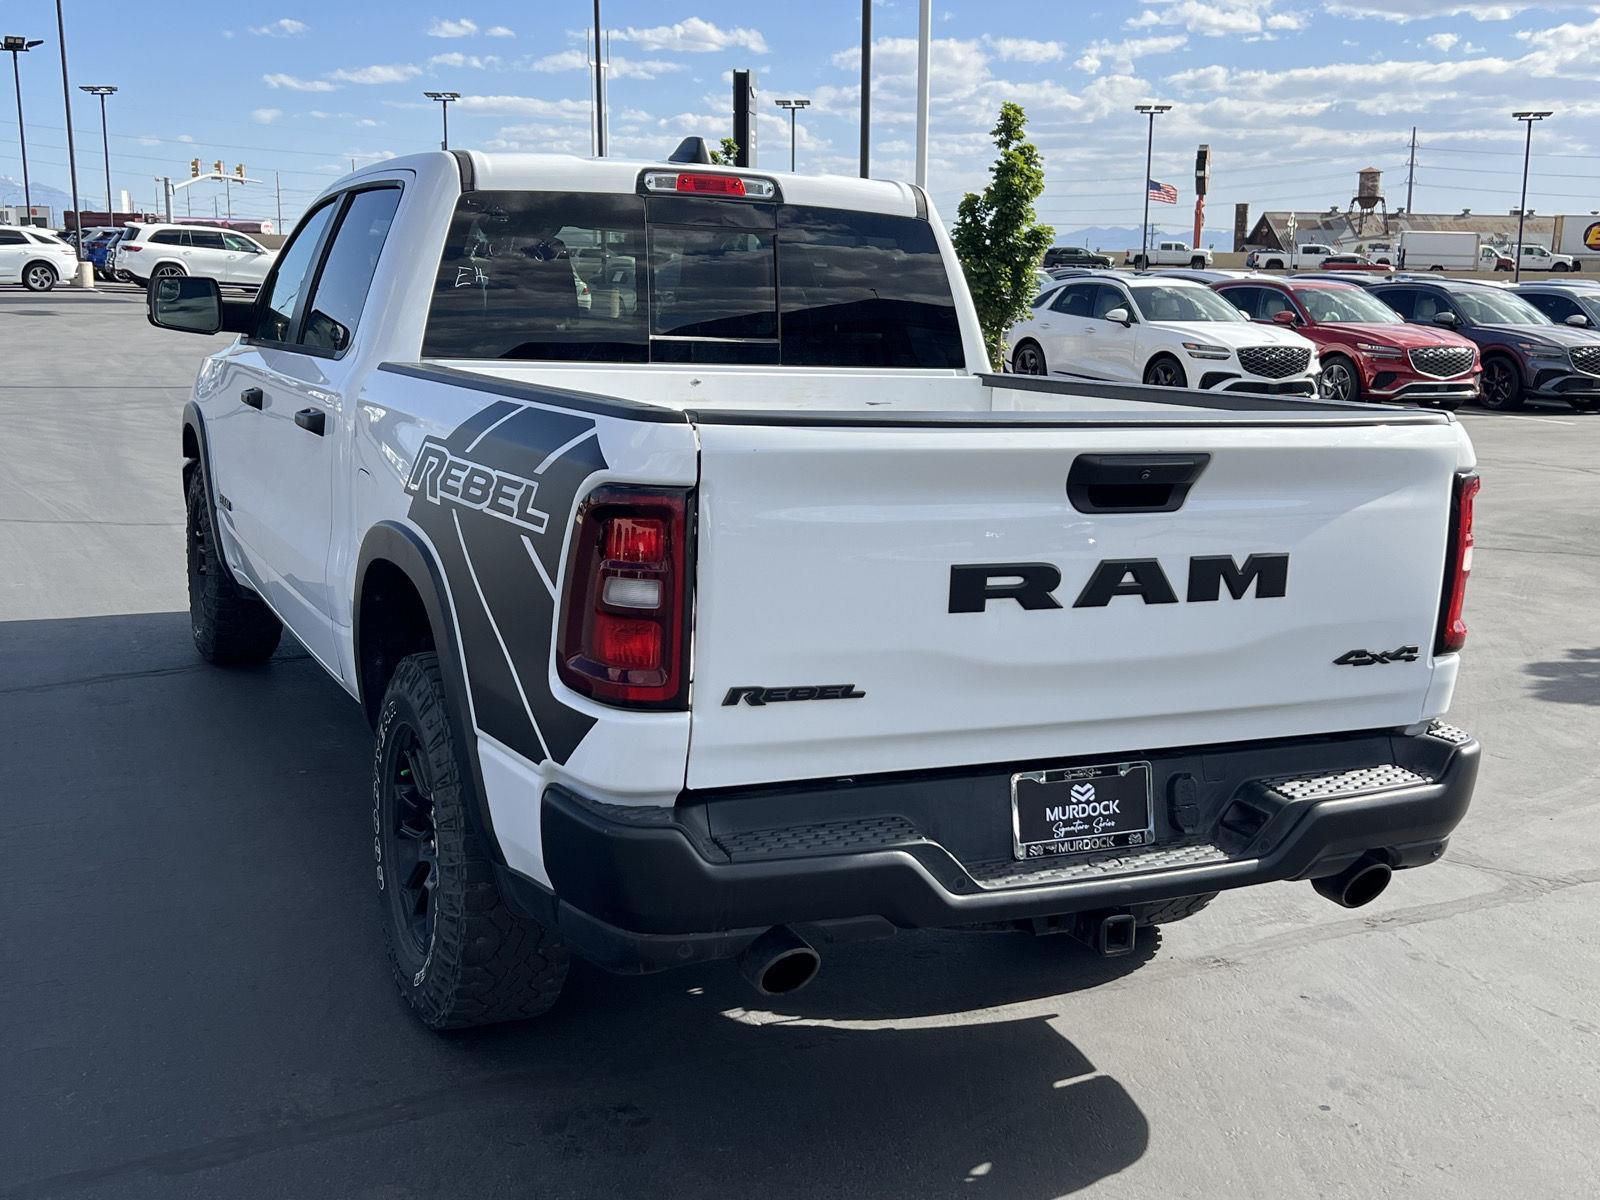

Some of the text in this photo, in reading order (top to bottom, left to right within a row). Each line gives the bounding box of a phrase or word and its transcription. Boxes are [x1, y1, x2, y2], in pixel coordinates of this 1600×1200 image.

[407, 441, 550, 535] REBEL
[948, 552, 1290, 614] RAM
[721, 683, 867, 707] REBEL
[1045, 799, 1121, 822] MURDOCK
[1052, 816, 1116, 839] Signature Series
[1058, 835, 1116, 854] MURDOCK
